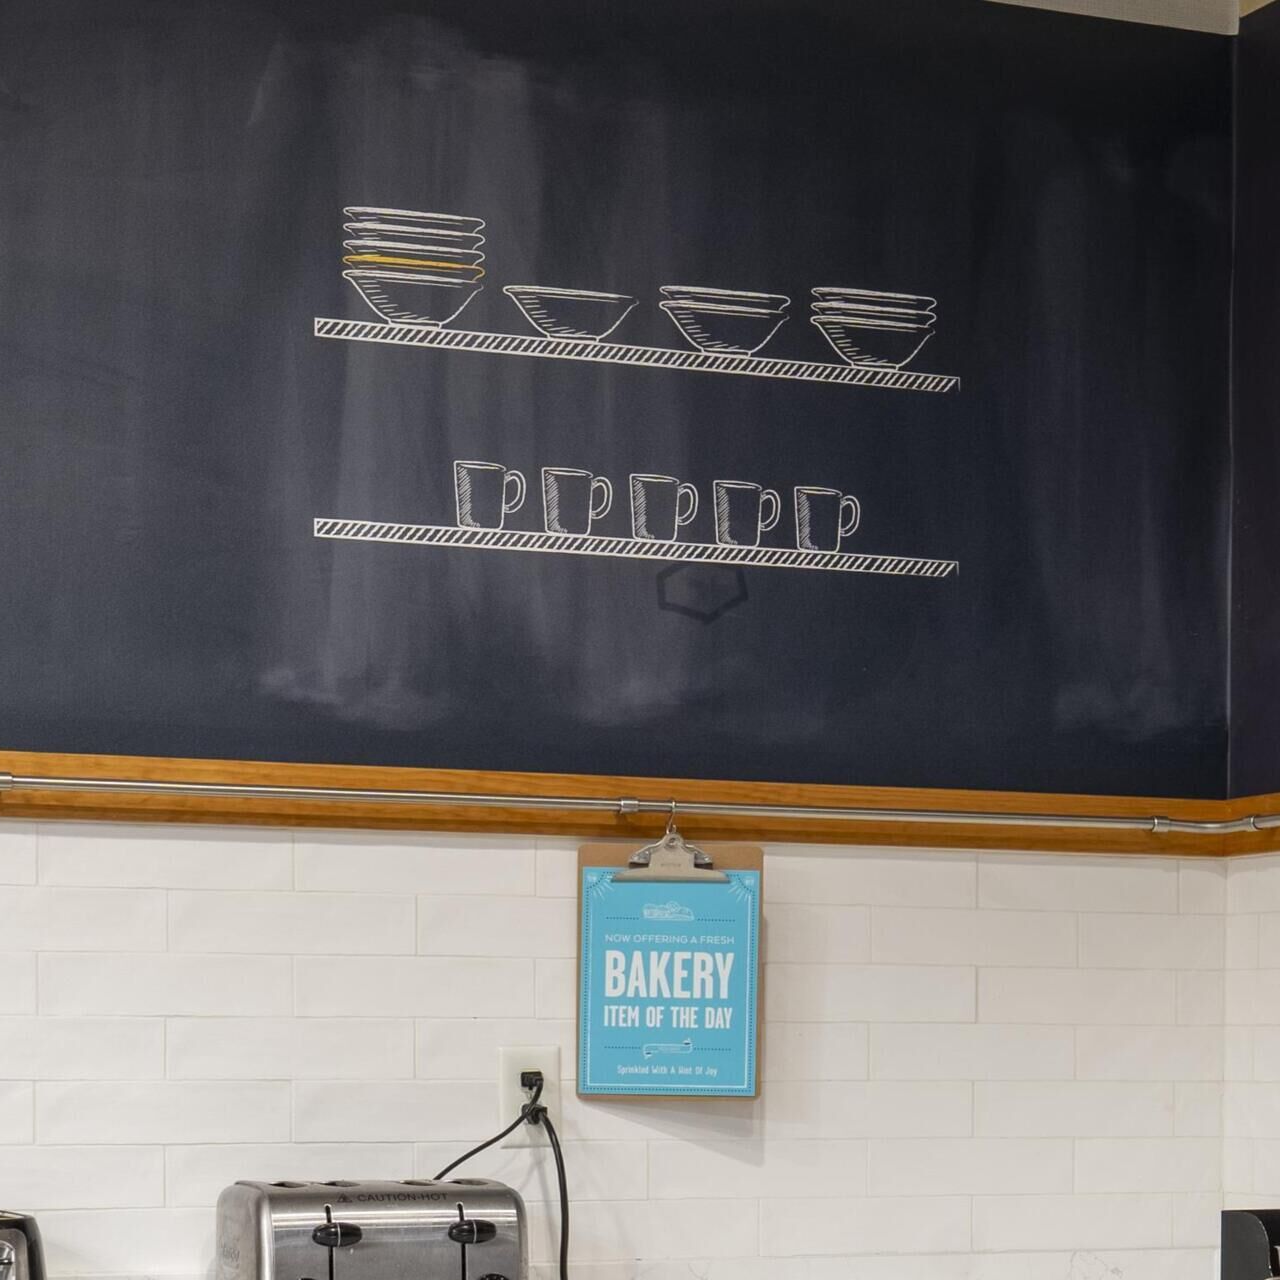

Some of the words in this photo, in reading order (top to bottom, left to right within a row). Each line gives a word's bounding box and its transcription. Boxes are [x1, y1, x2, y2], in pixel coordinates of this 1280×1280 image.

[604, 934, 631, 943] NOW
[633, 935, 688, 944] OFFERING
[690, 936, 698, 944] A
[699, 936, 735, 945] FRESH
[604, 950, 735, 999] BAKERY
[604, 1005, 639, 1027] ITEM
[646, 1006, 664, 1028] OF
[670, 1007, 699, 1029] THE
[705, 1007, 733, 1029] DAY
[357, 1192, 448, 1202] CAUTION-HOT
